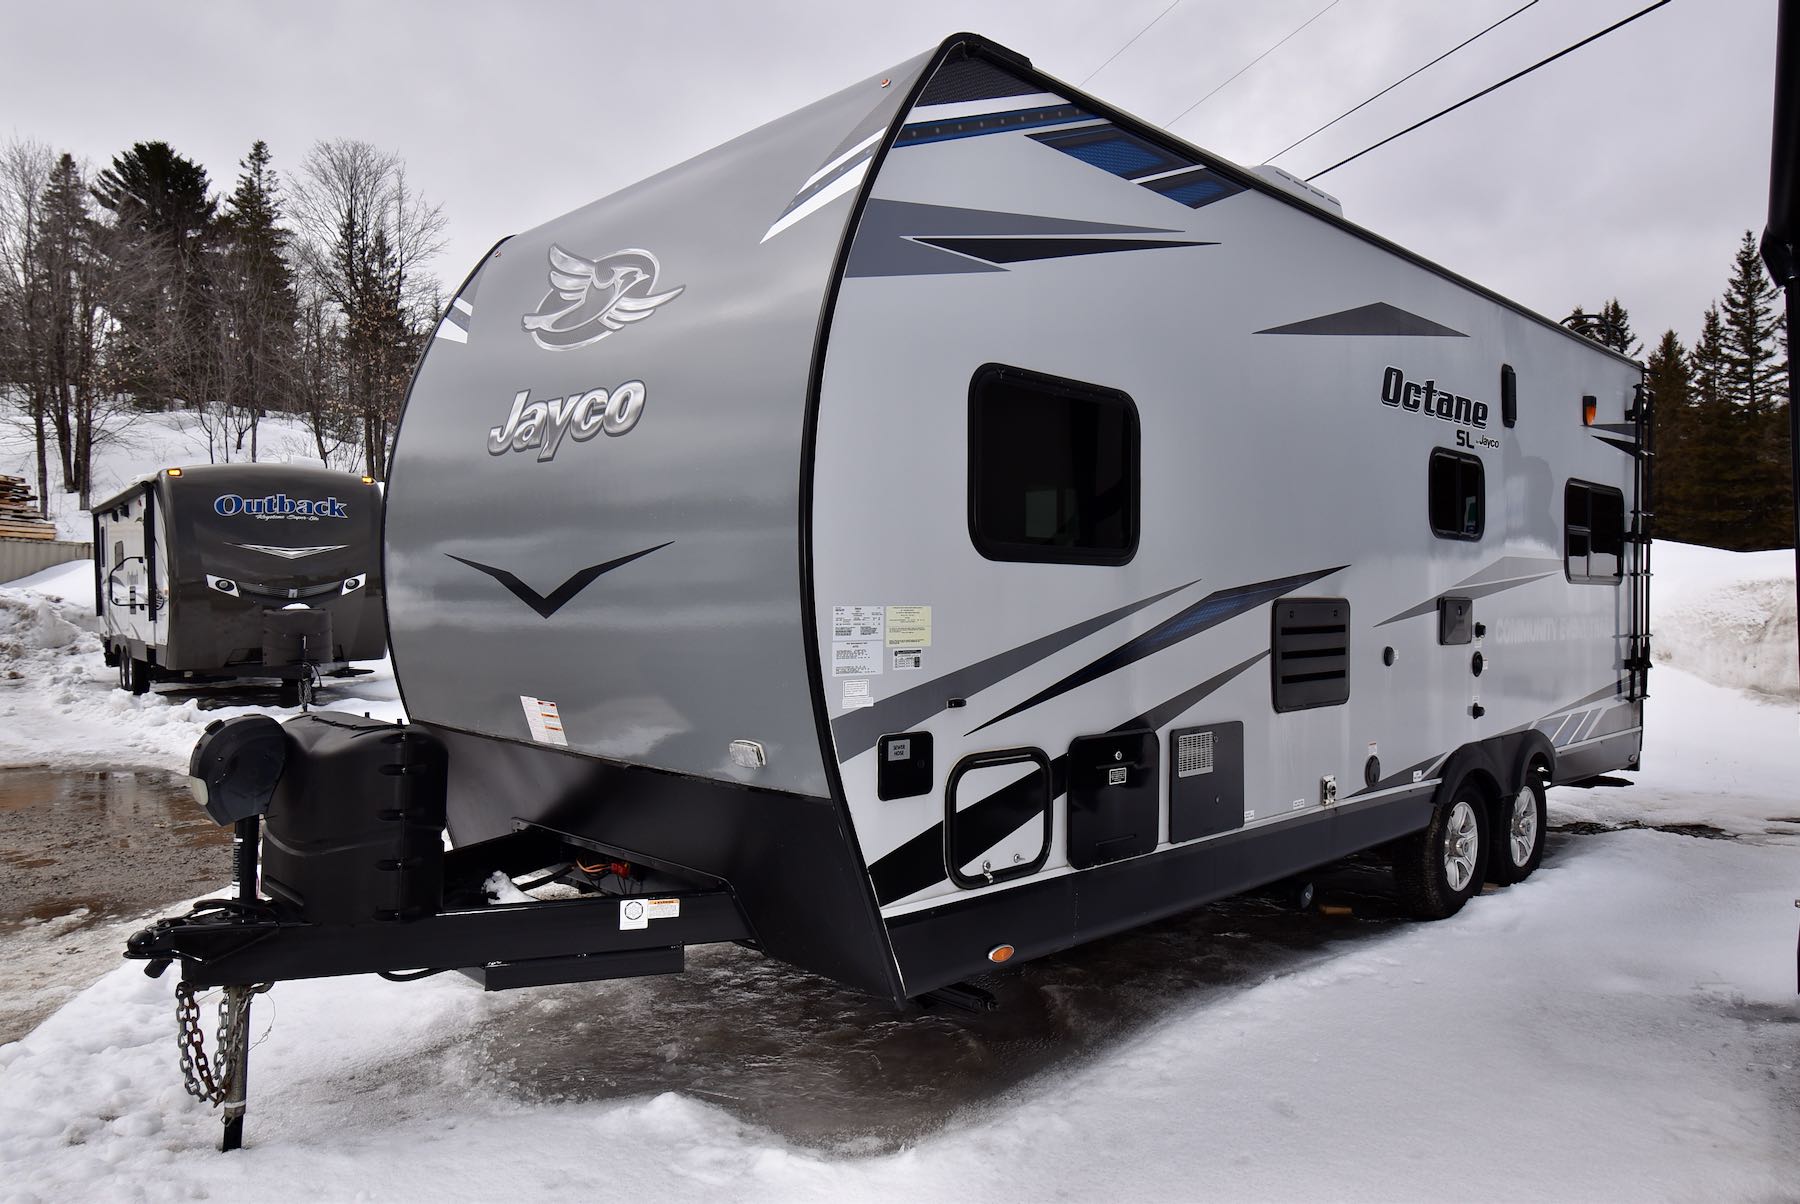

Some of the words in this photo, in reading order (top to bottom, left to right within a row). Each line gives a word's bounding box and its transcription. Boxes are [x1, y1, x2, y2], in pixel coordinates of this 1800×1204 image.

[1381, 365, 1489, 430] Octane
[487, 379, 647, 463] Jayco
[1456, 429, 1475, 449] SL
[1479, 434, 1500, 449] Jayco
[213, 493, 348, 518] Outback
